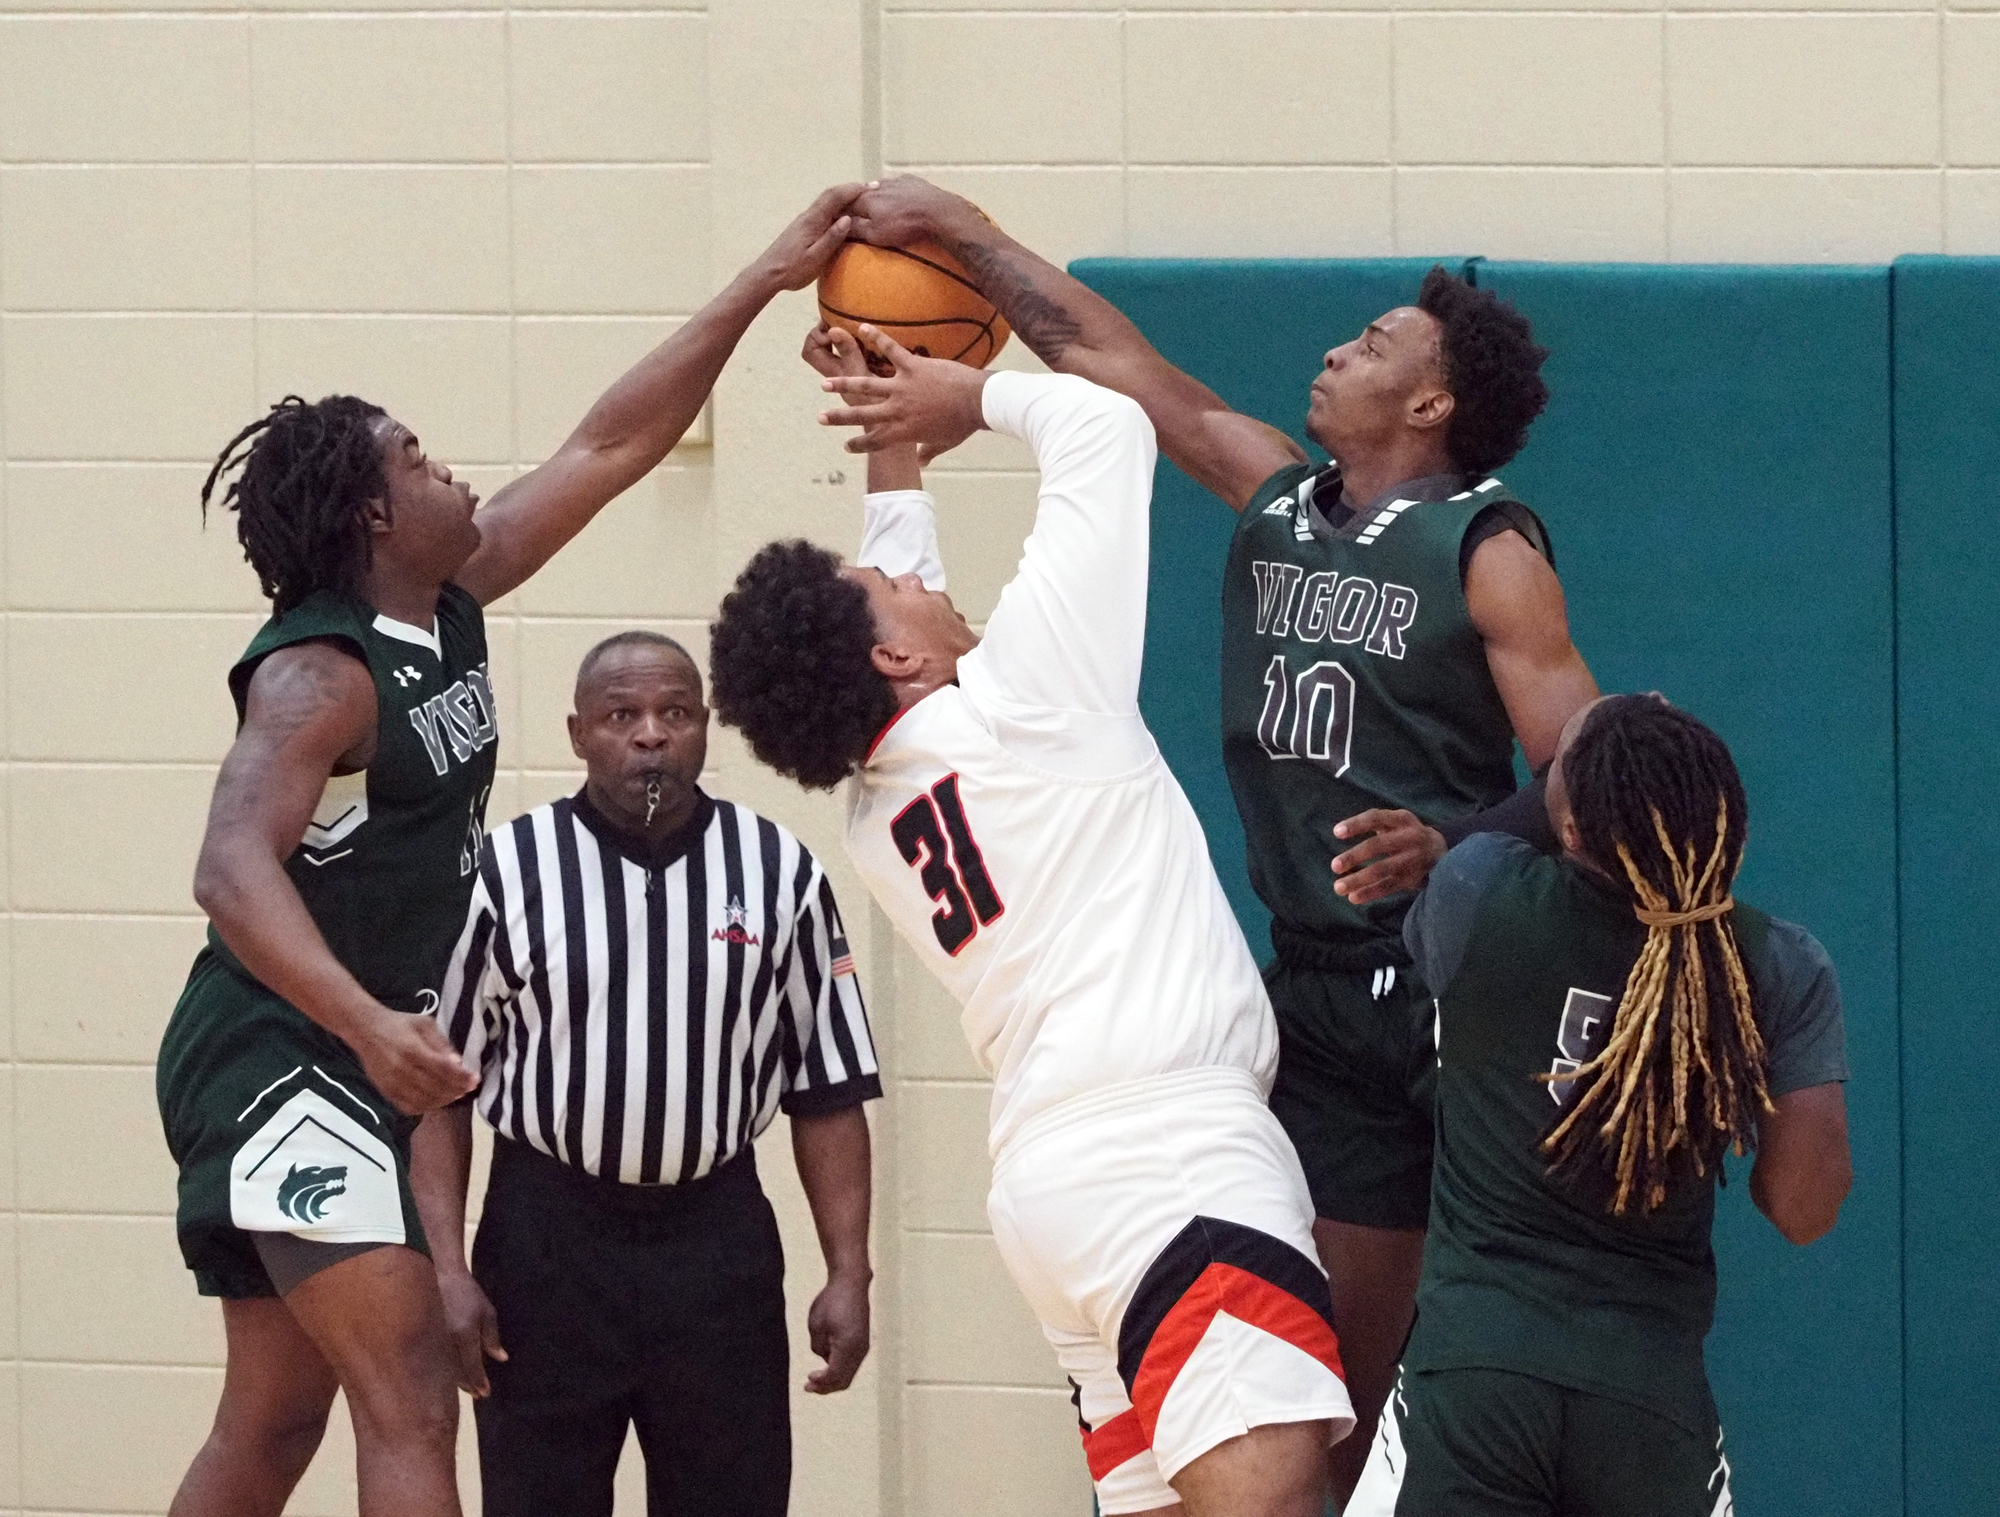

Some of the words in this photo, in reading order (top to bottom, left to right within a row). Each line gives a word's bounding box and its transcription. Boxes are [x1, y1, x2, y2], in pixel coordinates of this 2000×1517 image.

[1253, 561, 1418, 660] VIGOR
[1257, 655, 1355, 778] 10
[890, 772, 1005, 957] 31
[711, 928, 760, 948] AHSAA
